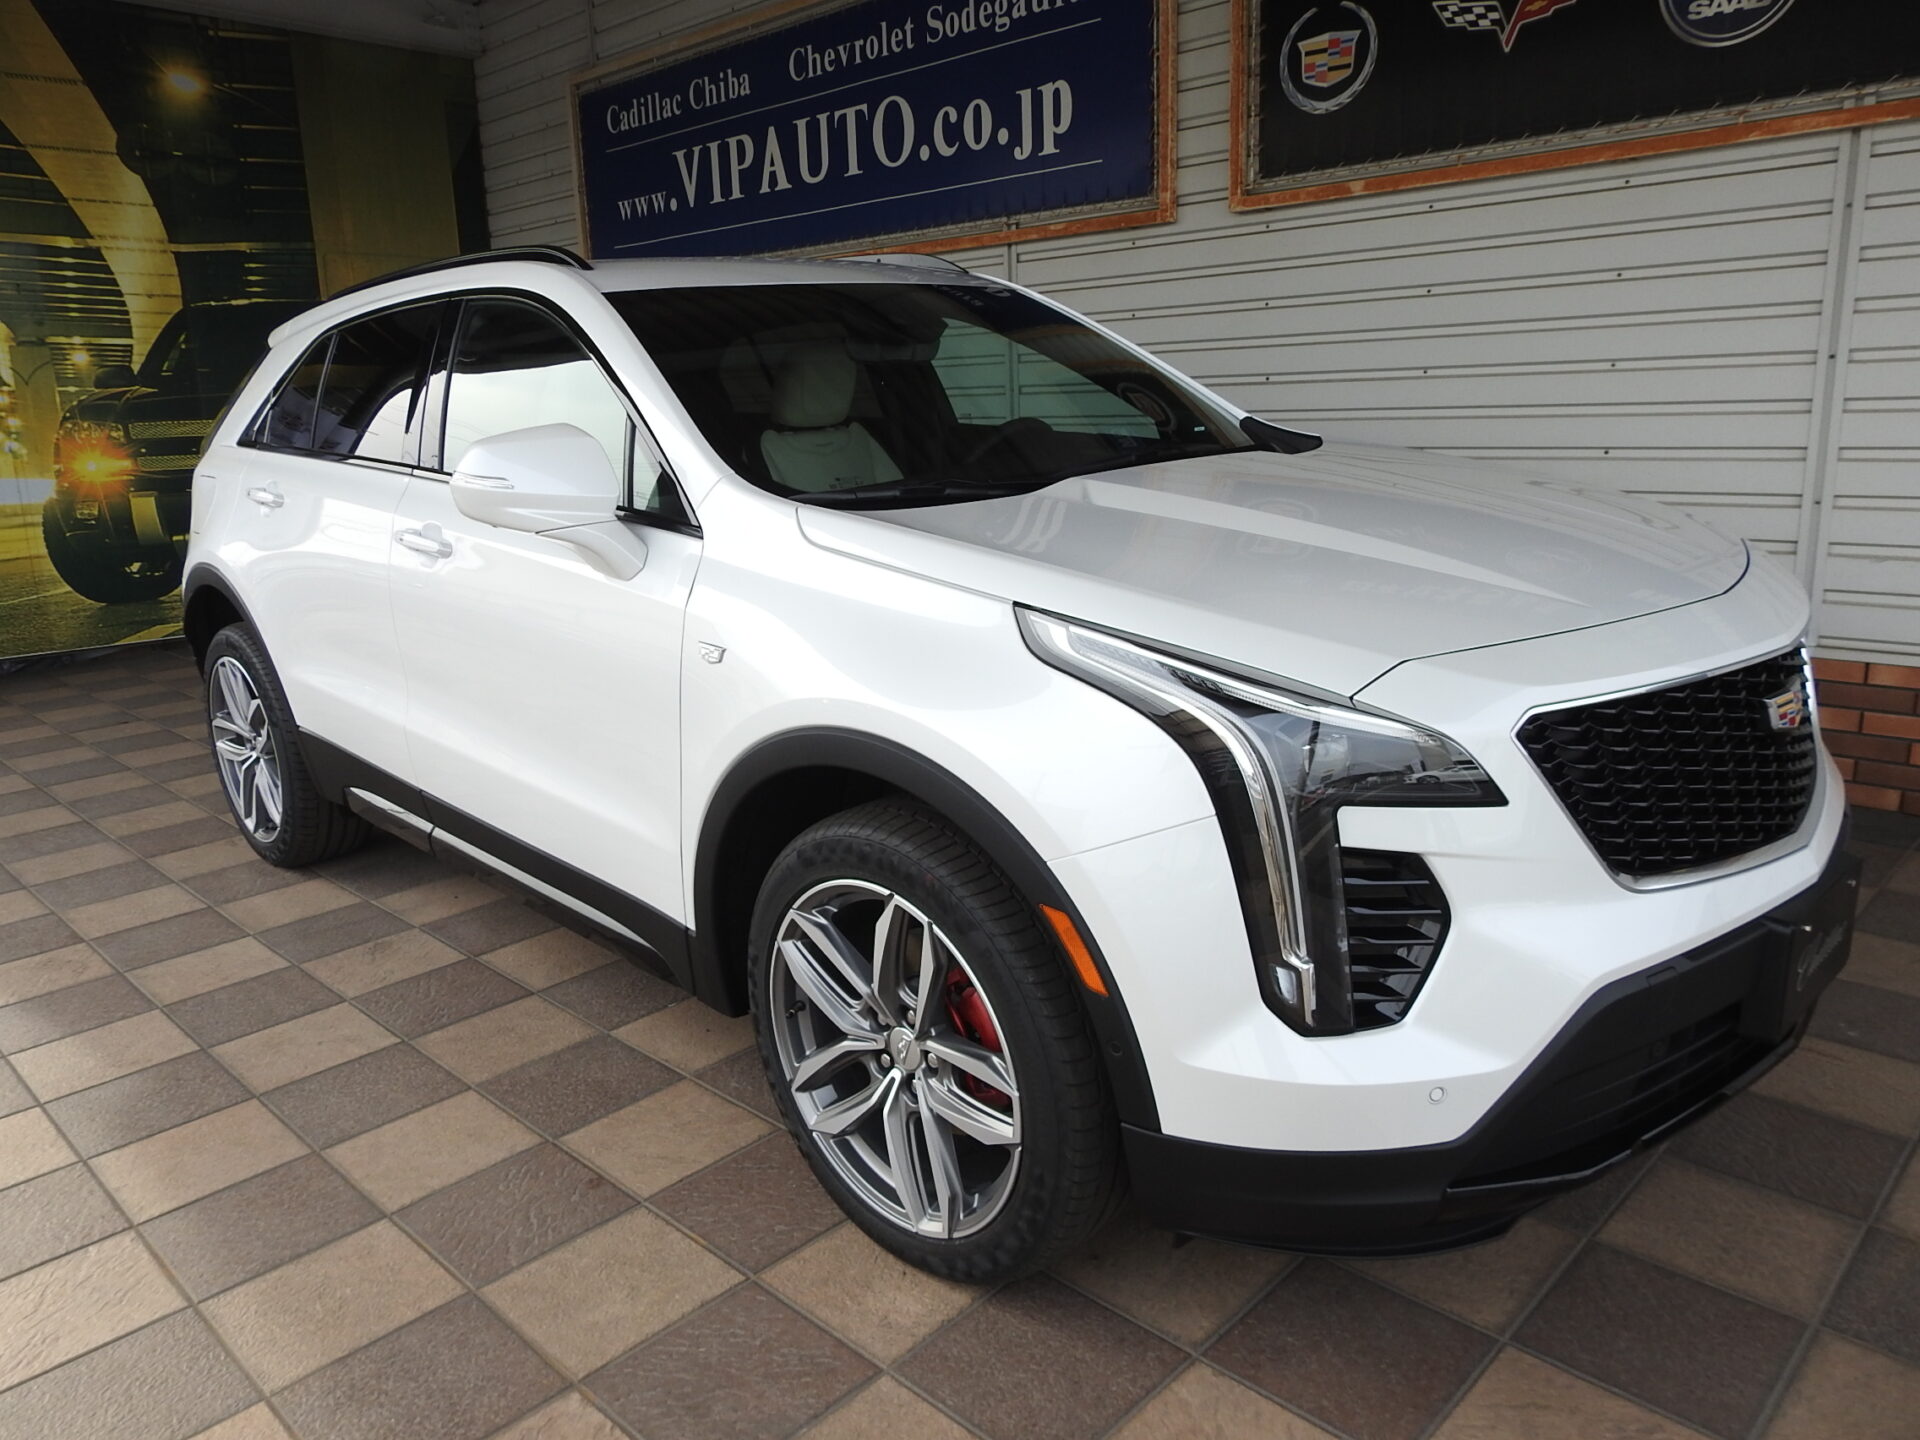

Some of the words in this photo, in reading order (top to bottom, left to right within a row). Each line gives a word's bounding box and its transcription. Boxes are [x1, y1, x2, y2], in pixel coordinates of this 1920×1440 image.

[788, 17, 915, 81] Chevrolet
[926, 0, 1079, 43] Sodega
[606, 92, 682, 134] Cadillac
[688, 68, 751, 110] Chiba
[617, 78, 1073, 221] www.VIPAUTO.co.jp
